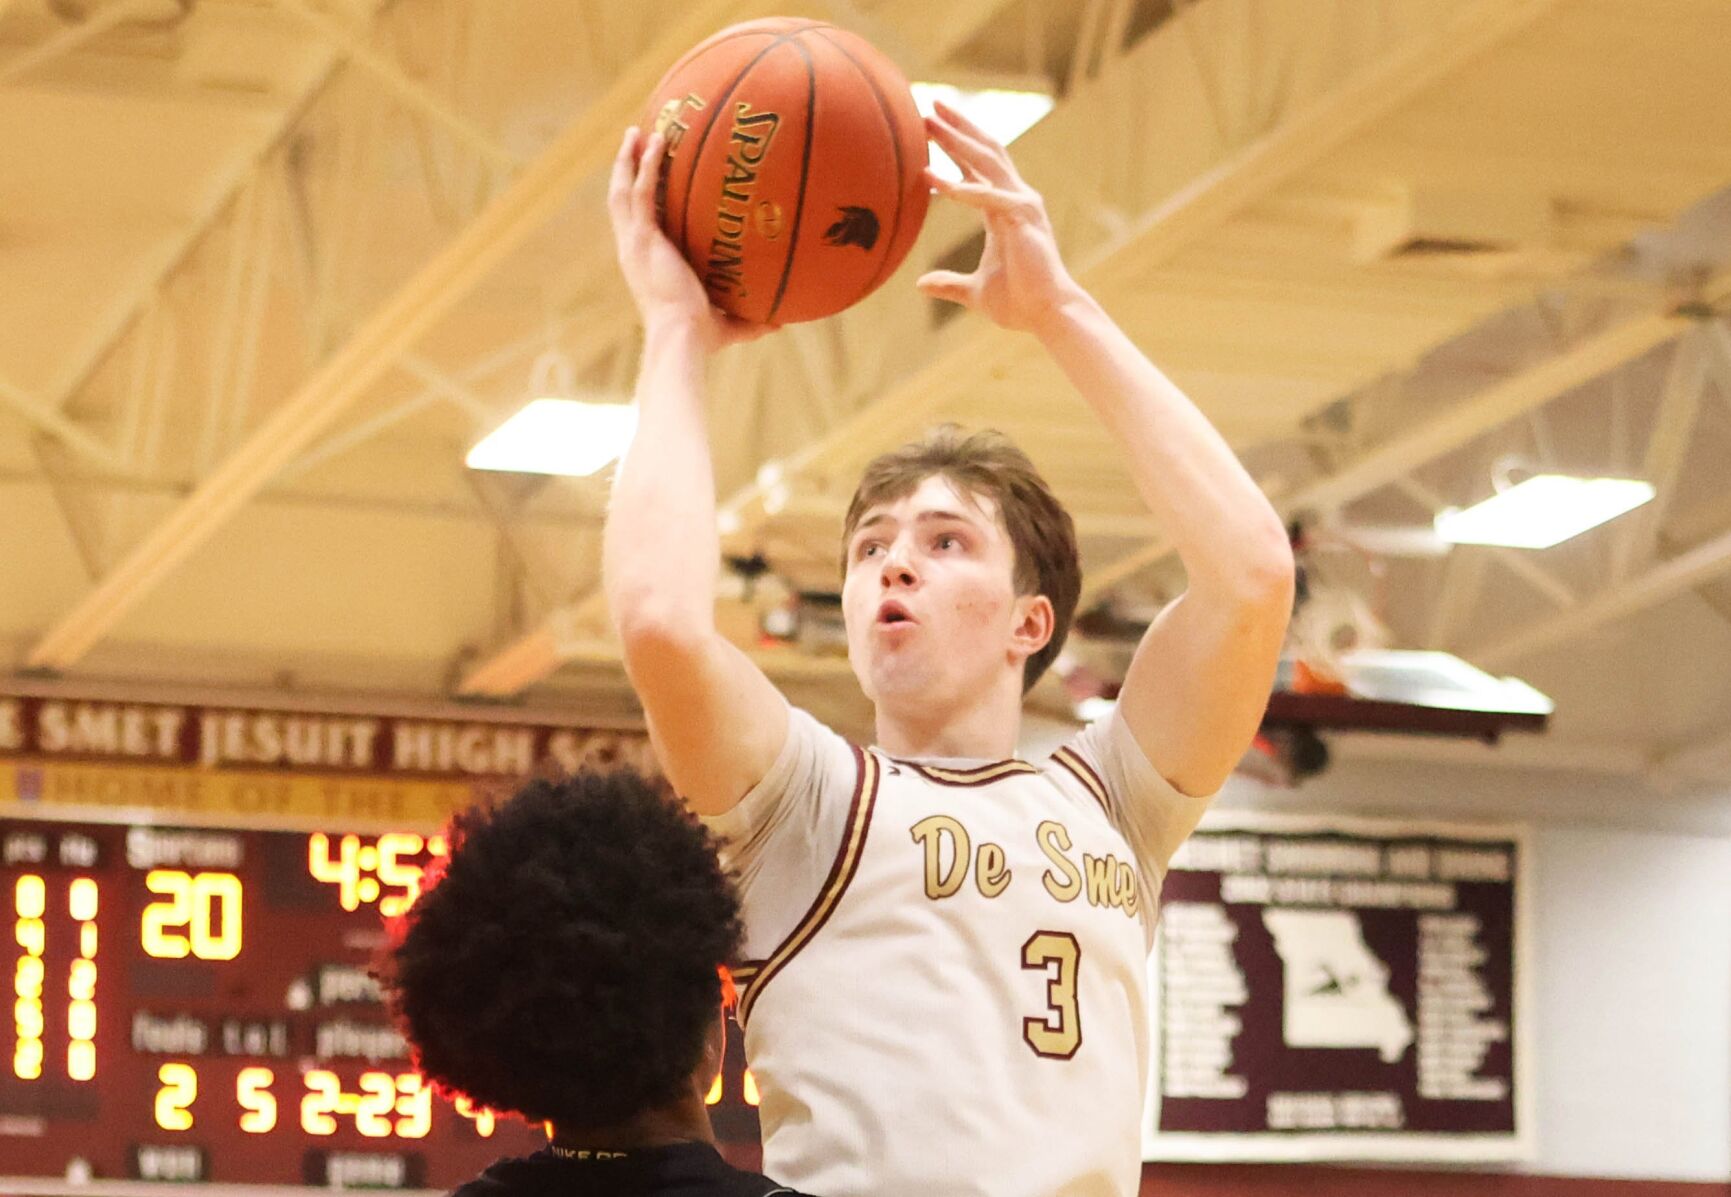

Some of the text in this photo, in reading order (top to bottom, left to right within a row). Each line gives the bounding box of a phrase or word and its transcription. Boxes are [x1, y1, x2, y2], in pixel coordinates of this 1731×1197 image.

[706, 102, 779, 294] SPALDING
[37, 701, 181, 758] SMET
[201, 711, 378, 770] JESUIT
[392, 720, 532, 775] HIGH
[310, 827, 447, 916] 4:5
[909, 814, 1012, 901] De
[142, 871, 242, 960] 20
[1020, 929, 1083, 1062] 3
[156, 1064, 196, 1130] 2
[237, 1068, 276, 1132] 5
